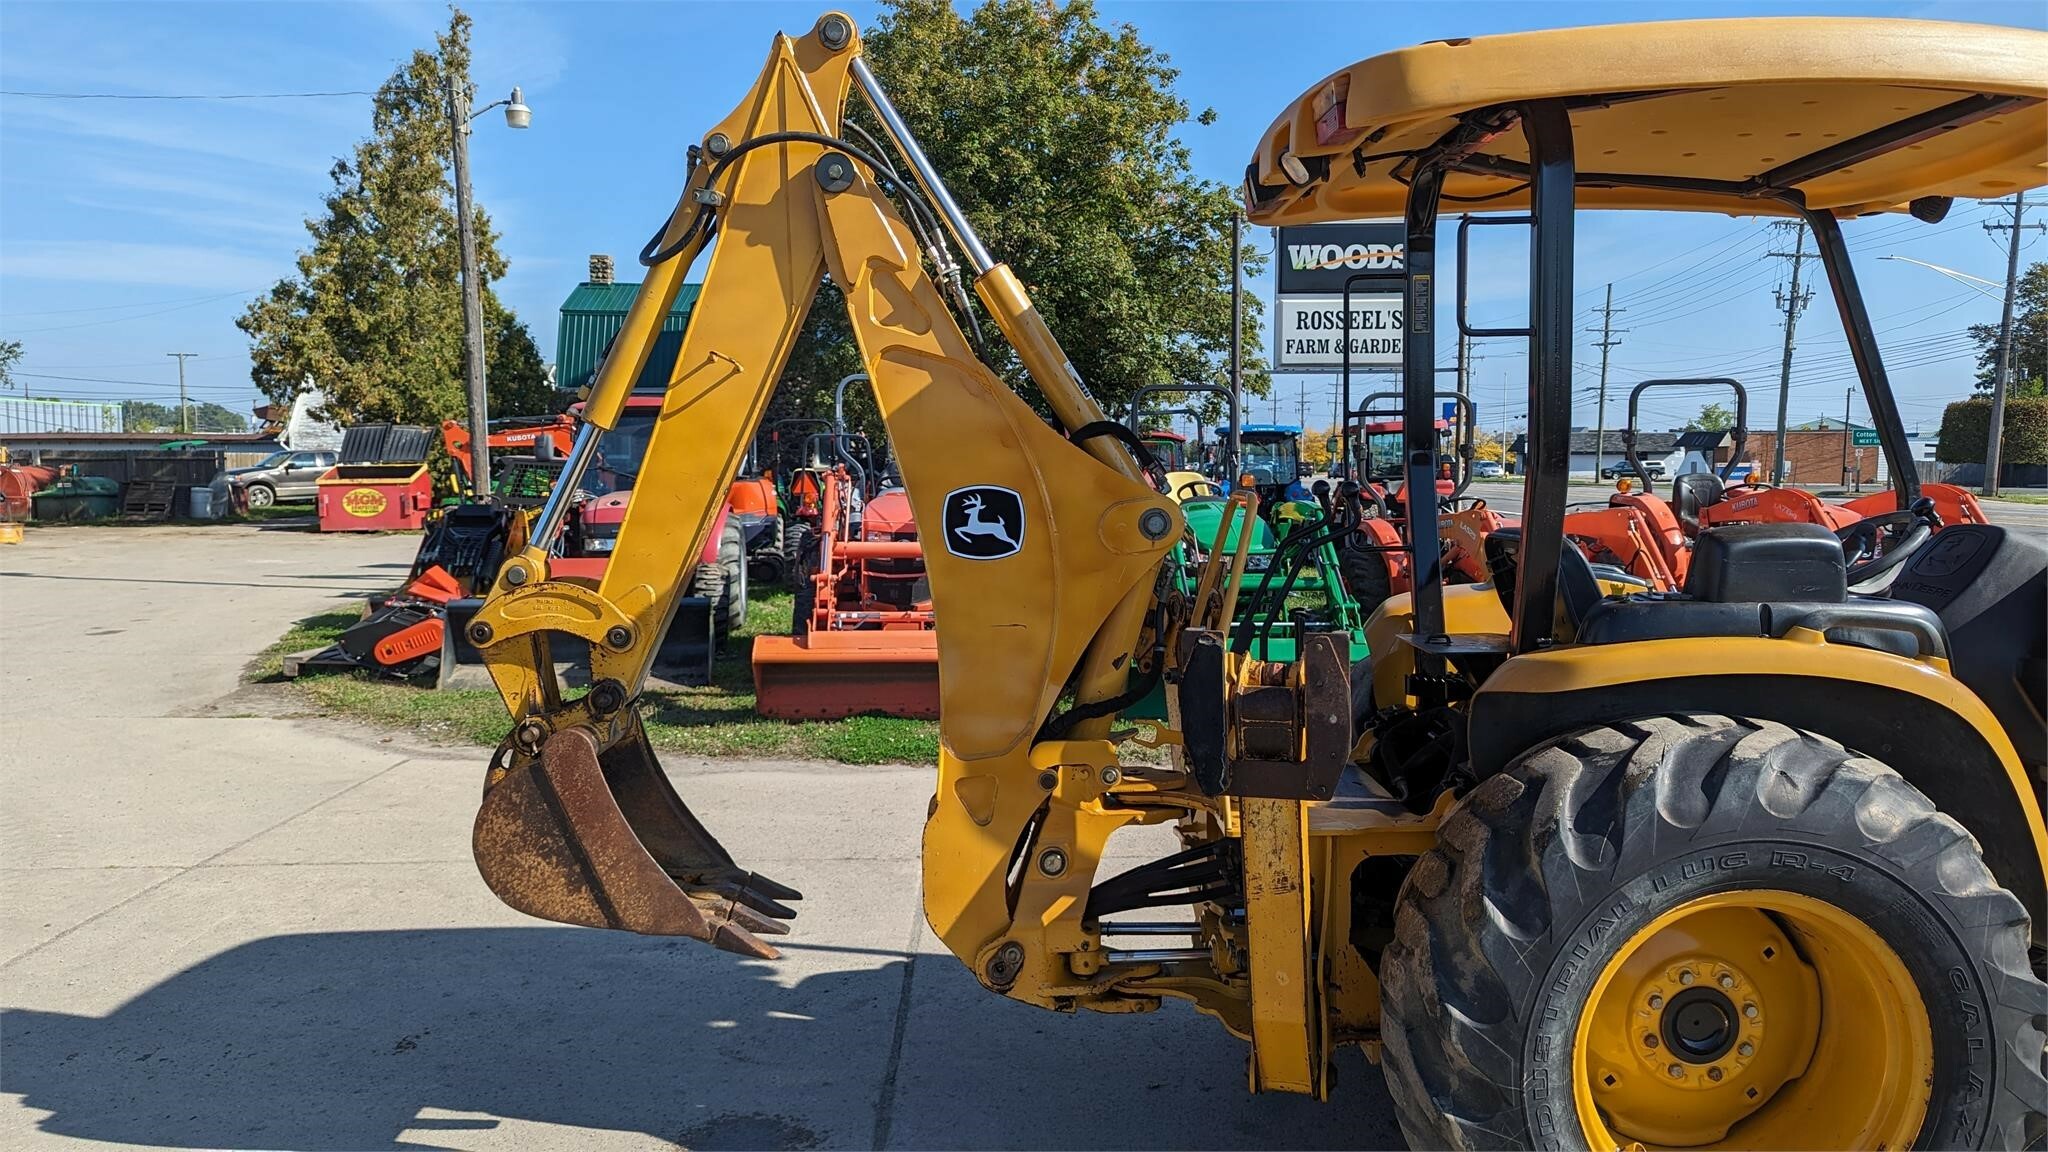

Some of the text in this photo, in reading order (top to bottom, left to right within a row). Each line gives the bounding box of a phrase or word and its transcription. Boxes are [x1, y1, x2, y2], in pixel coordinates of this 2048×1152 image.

[1287, 243, 1404, 271] WOODS
[1296, 310, 1403, 331] ROSSEEL'S
[1285, 338, 1404, 355] FARM & GARDE
[506, 433, 536, 442] KUBOTA
[345, 494, 385, 505] MGM
[1731, 497, 1759, 512] KUBOTA
[1652, 851, 1750, 894] LUG
[1771, 849, 1857, 882] R-4
